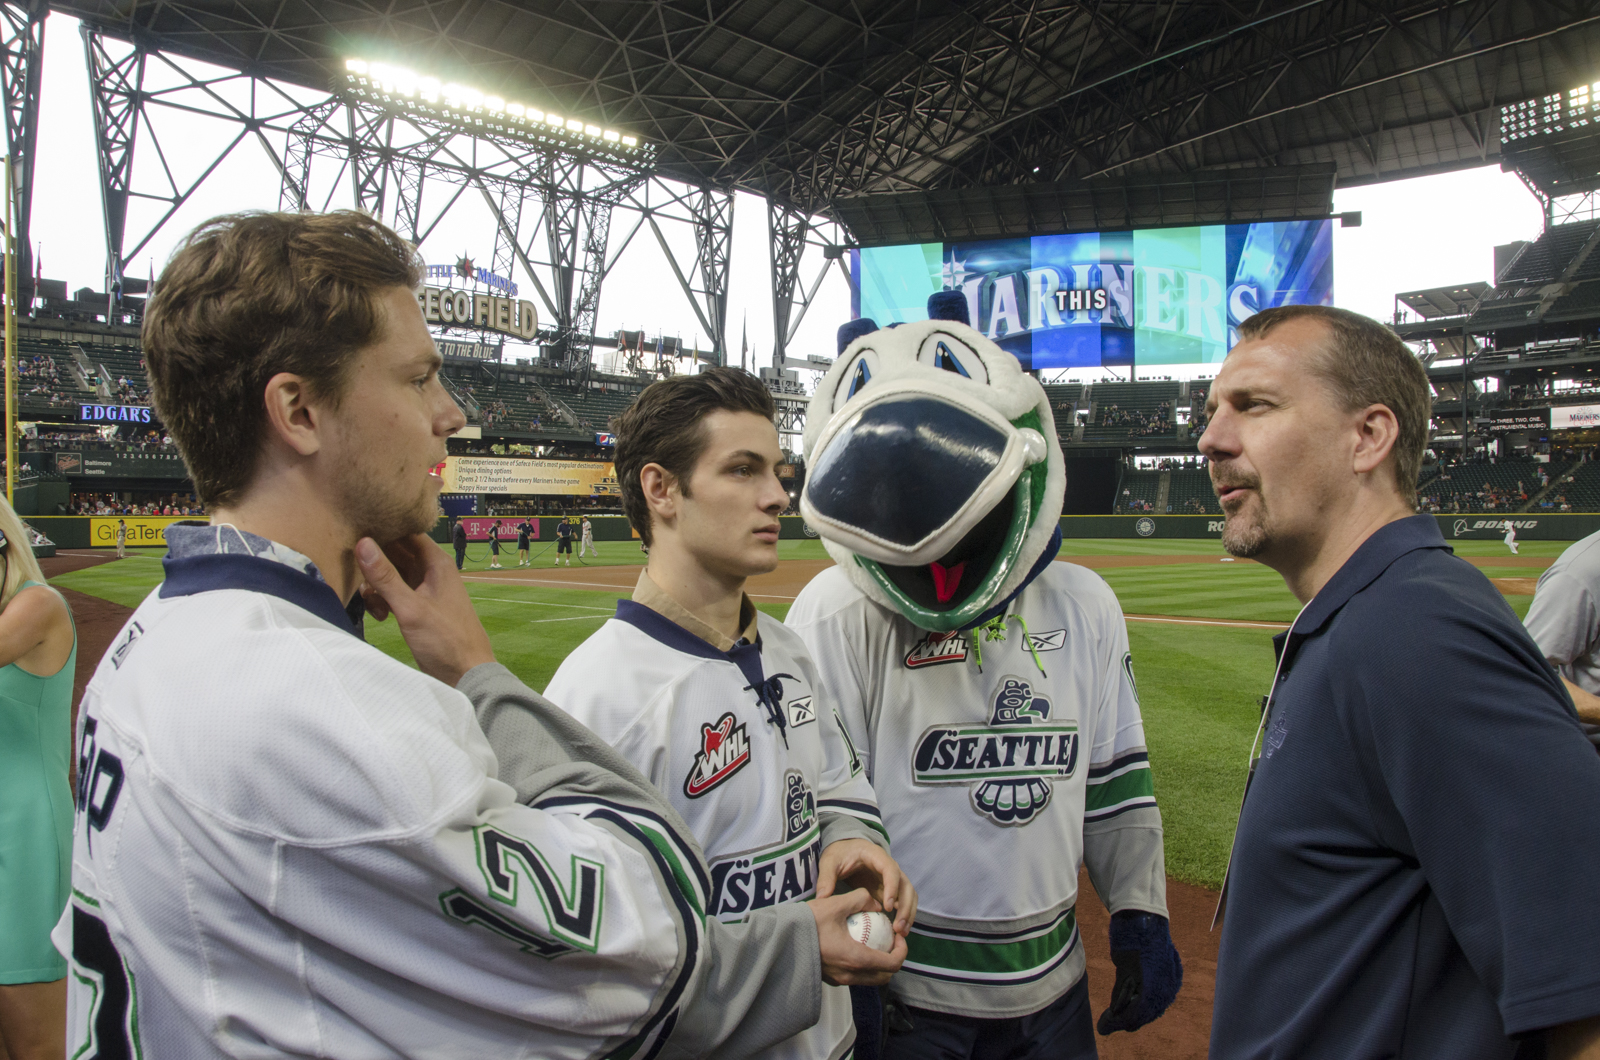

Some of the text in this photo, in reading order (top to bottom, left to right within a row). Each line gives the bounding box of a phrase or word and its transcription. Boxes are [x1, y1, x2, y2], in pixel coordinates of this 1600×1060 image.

[426, 264, 518, 296] TTLE MARINERS
[1056, 290, 1106, 312] THIS
[473, 294, 538, 340] FIELD
[444, 342, 456, 356] TO
[456, 344, 472, 358] THE
[472, 344, 494, 359] BLUE
[477, 467, 493, 475] dining
[1208, 521, 1225, 532] RO
[1472, 520, 1538, 528] BOENG
[698, 728, 748, 780] WHL
[930, 734, 1071, 770] SEATTLE
